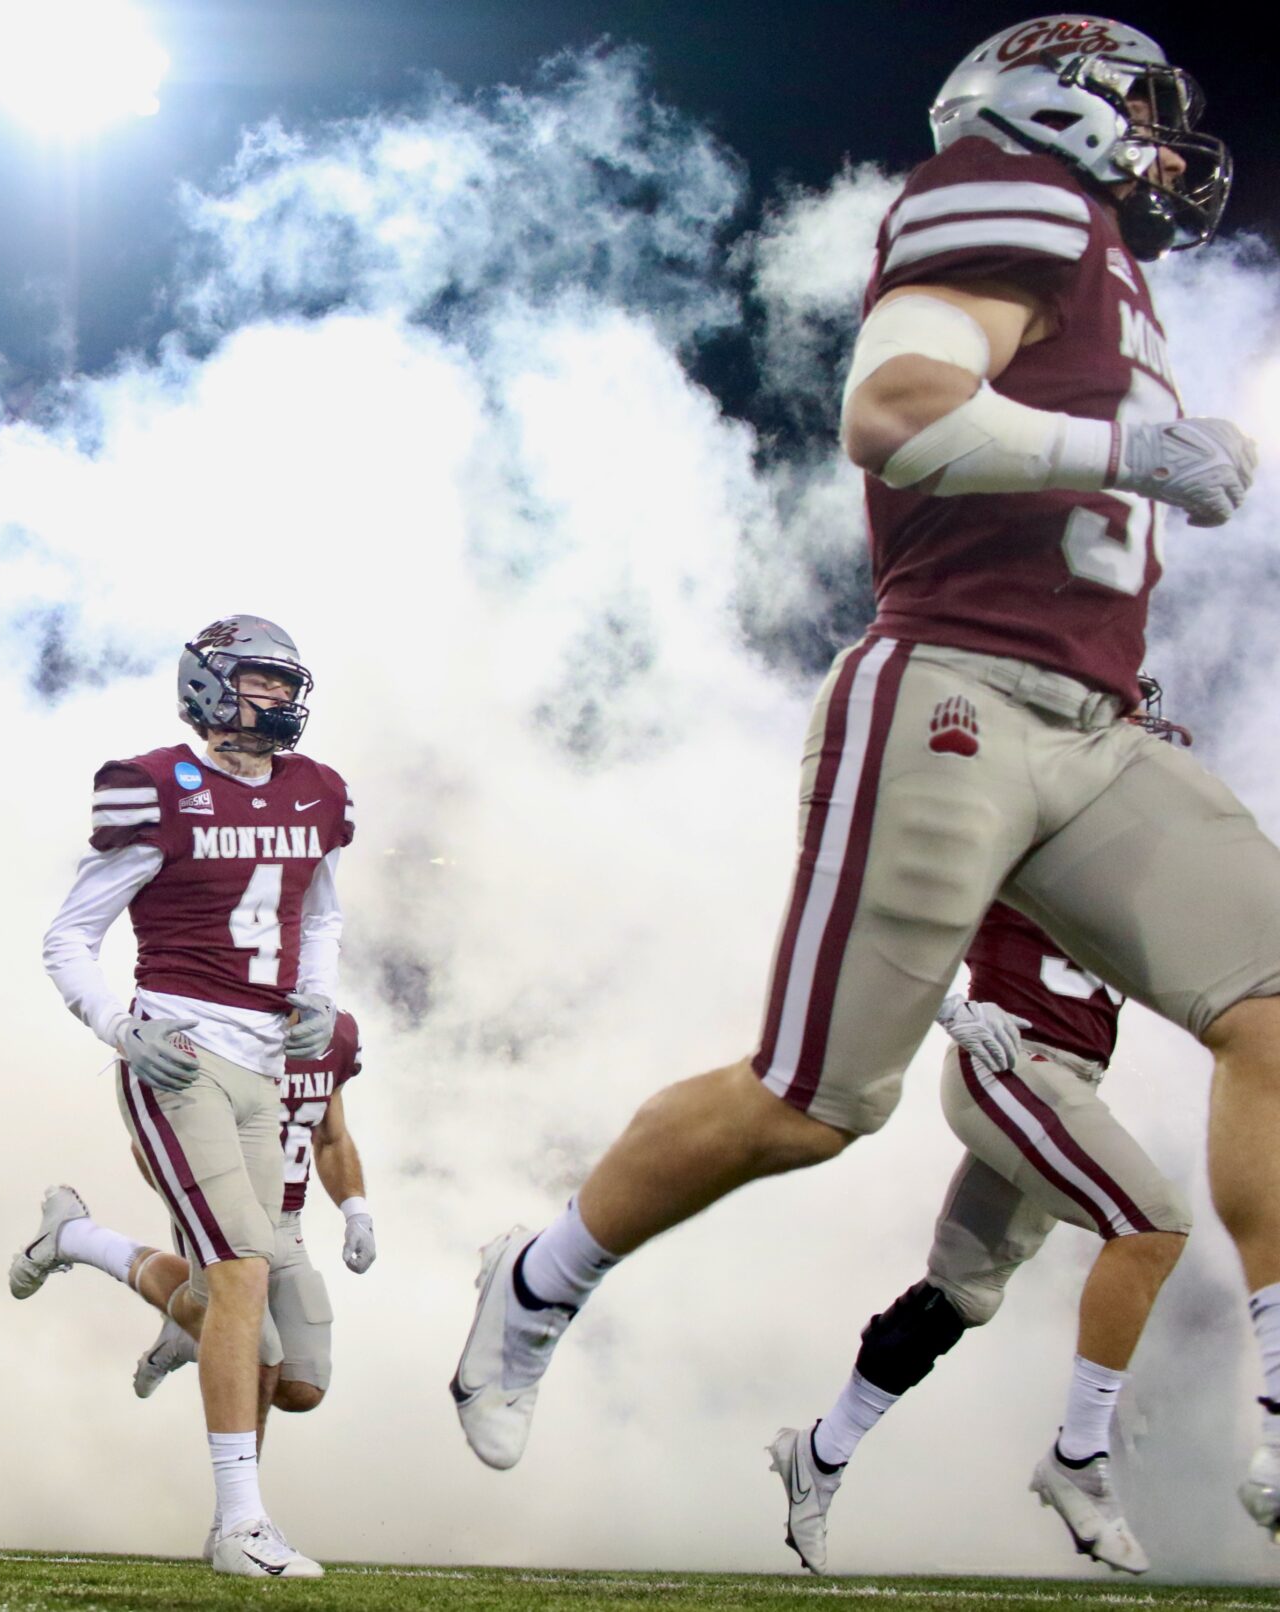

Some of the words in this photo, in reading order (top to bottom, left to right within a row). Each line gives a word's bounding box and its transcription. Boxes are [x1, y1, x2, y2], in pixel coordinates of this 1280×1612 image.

[997, 20, 1119, 62] Griz
[192, 825, 323, 860] MONTANA
[229, 863, 284, 986] 4
